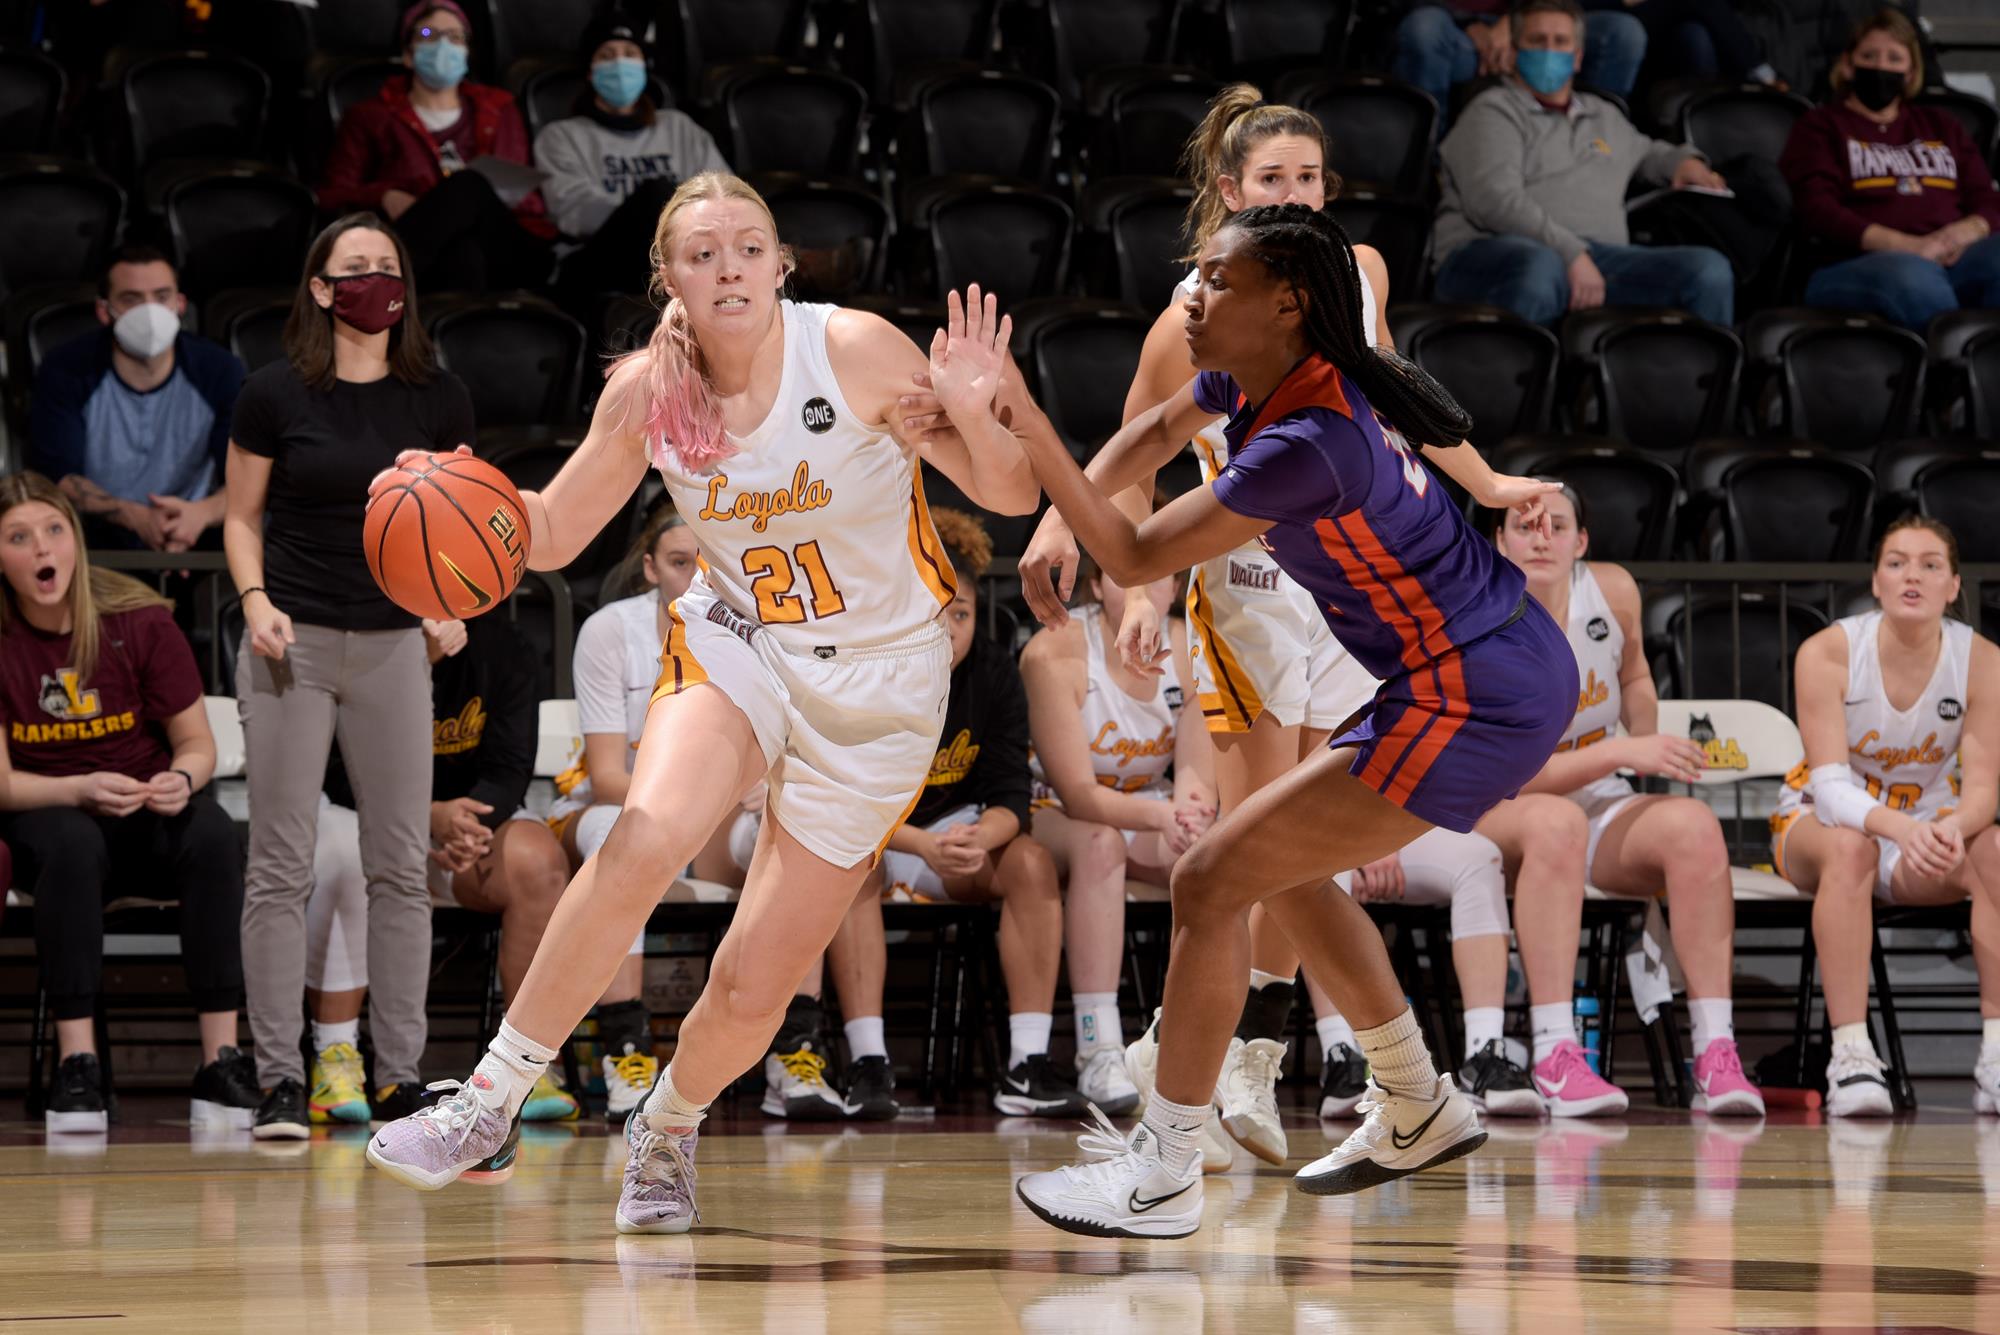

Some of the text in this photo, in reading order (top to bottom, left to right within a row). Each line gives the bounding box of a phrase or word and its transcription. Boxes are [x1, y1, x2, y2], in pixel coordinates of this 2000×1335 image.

[603, 154, 672, 175] SAINT
[1848, 139, 1957, 179] RAMBLERS
[804, 404, 833, 426] ONE
[699, 460, 832, 533] Loyola
[740, 539, 847, 625] 21
[1229, 560, 1282, 591] VALLEY
[12, 711, 135, 743] RAMBLERS
[1849, 729, 1945, 774] Loyola
